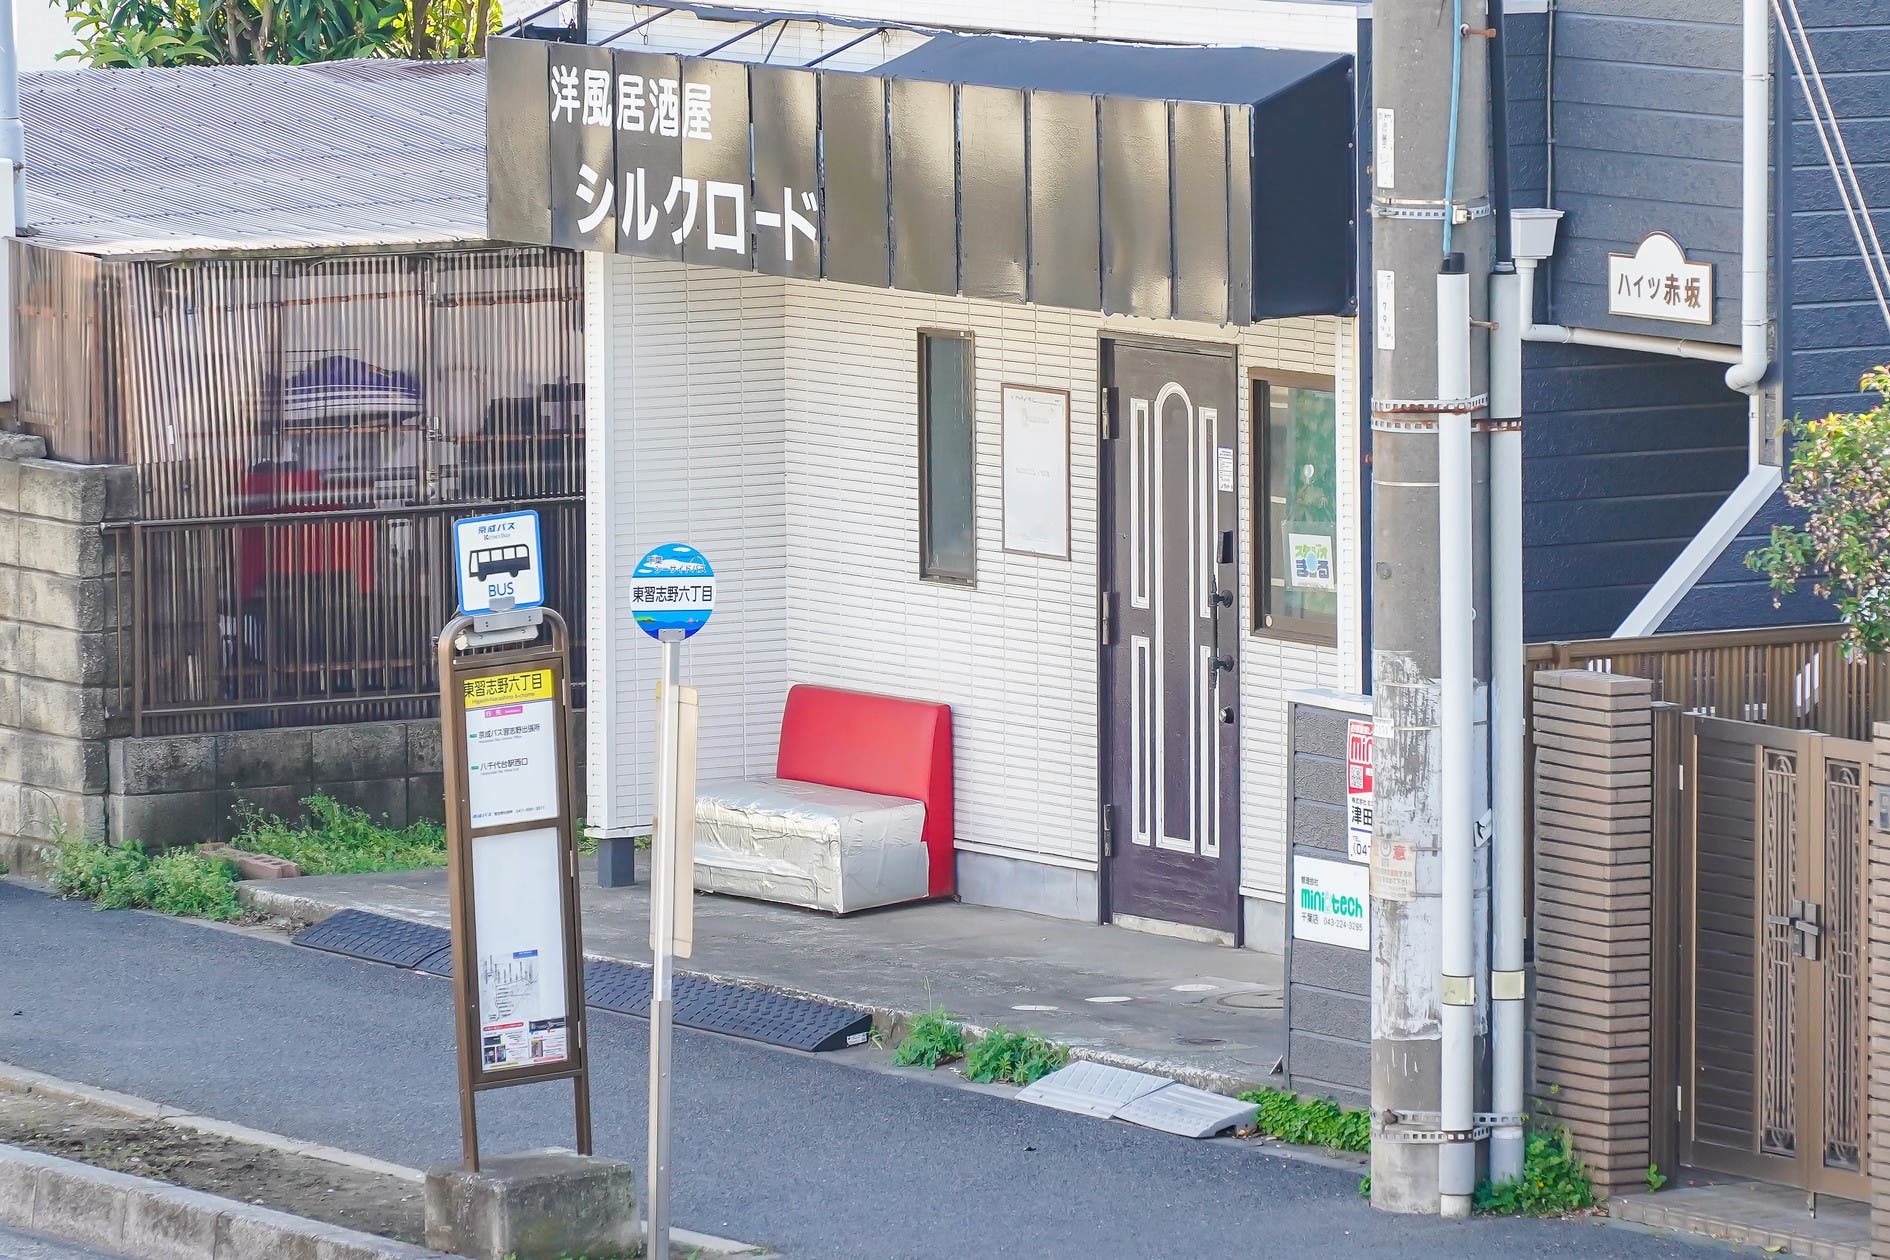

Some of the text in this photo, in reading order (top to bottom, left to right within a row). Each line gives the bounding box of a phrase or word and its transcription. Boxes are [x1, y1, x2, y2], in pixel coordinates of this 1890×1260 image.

[551, 64, 712, 140] 洋風居酒屋
[576, 163, 818, 262] シルクロード
[1618, 273, 1701, 309] ハイツ赤坂
[488, 582, 515, 597] BUS
[632, 585, 713, 603] 東習志野六丁目
[464, 673, 542, 698] 東習志野六丁目
